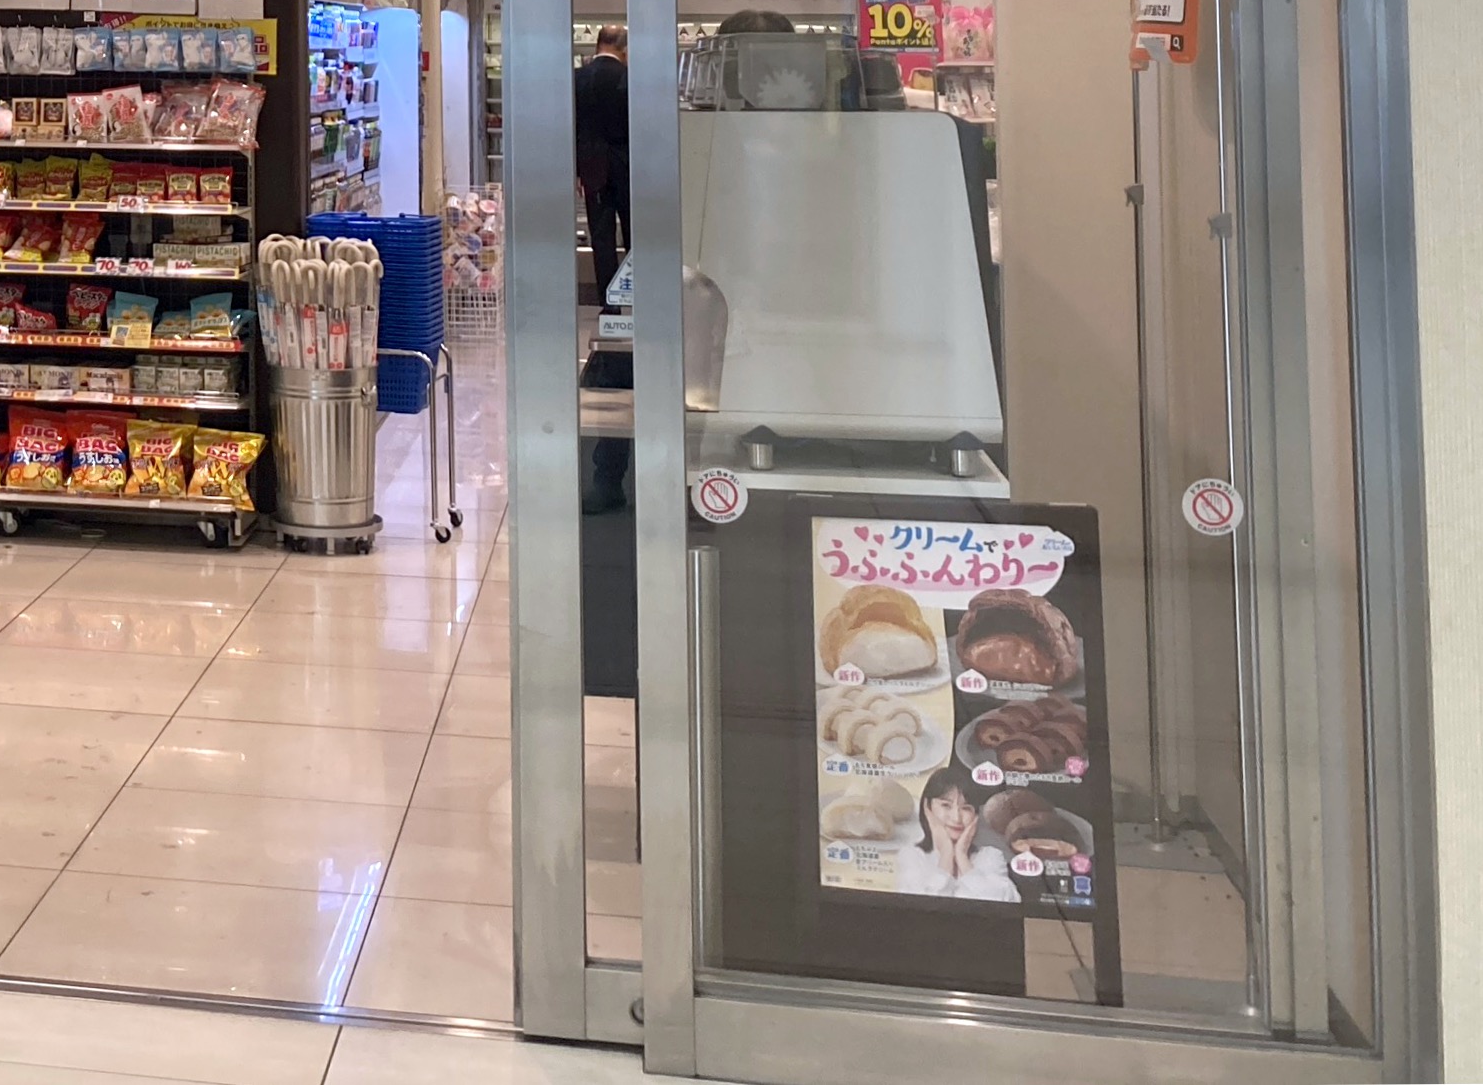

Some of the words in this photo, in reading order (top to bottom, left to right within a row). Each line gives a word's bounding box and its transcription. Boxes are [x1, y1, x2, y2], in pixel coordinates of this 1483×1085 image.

[867, 3, 934, 39] 10%
[120, 198, 137, 208] 50
[197, 245, 238, 257] PISTACHIO
[98, 259, 116, 271] 70
[603, 322, 627, 330] AUTO
[22, 425, 58, 437] BIG
[76, 438, 117, 452] BAG
[704, 510, 738, 522] CAUTION
[1196, 522, 1233, 534] CAUTION
[890, 525, 998, 553] クリームで
[837, 669, 861, 682] 新作
[960, 676, 984, 690] 新作
[825, 759, 849, 773] 定番
[976, 769, 1000, 782] 新作
[826, 846, 851, 861] 定番
[1016, 859, 1040, 872] 新作
